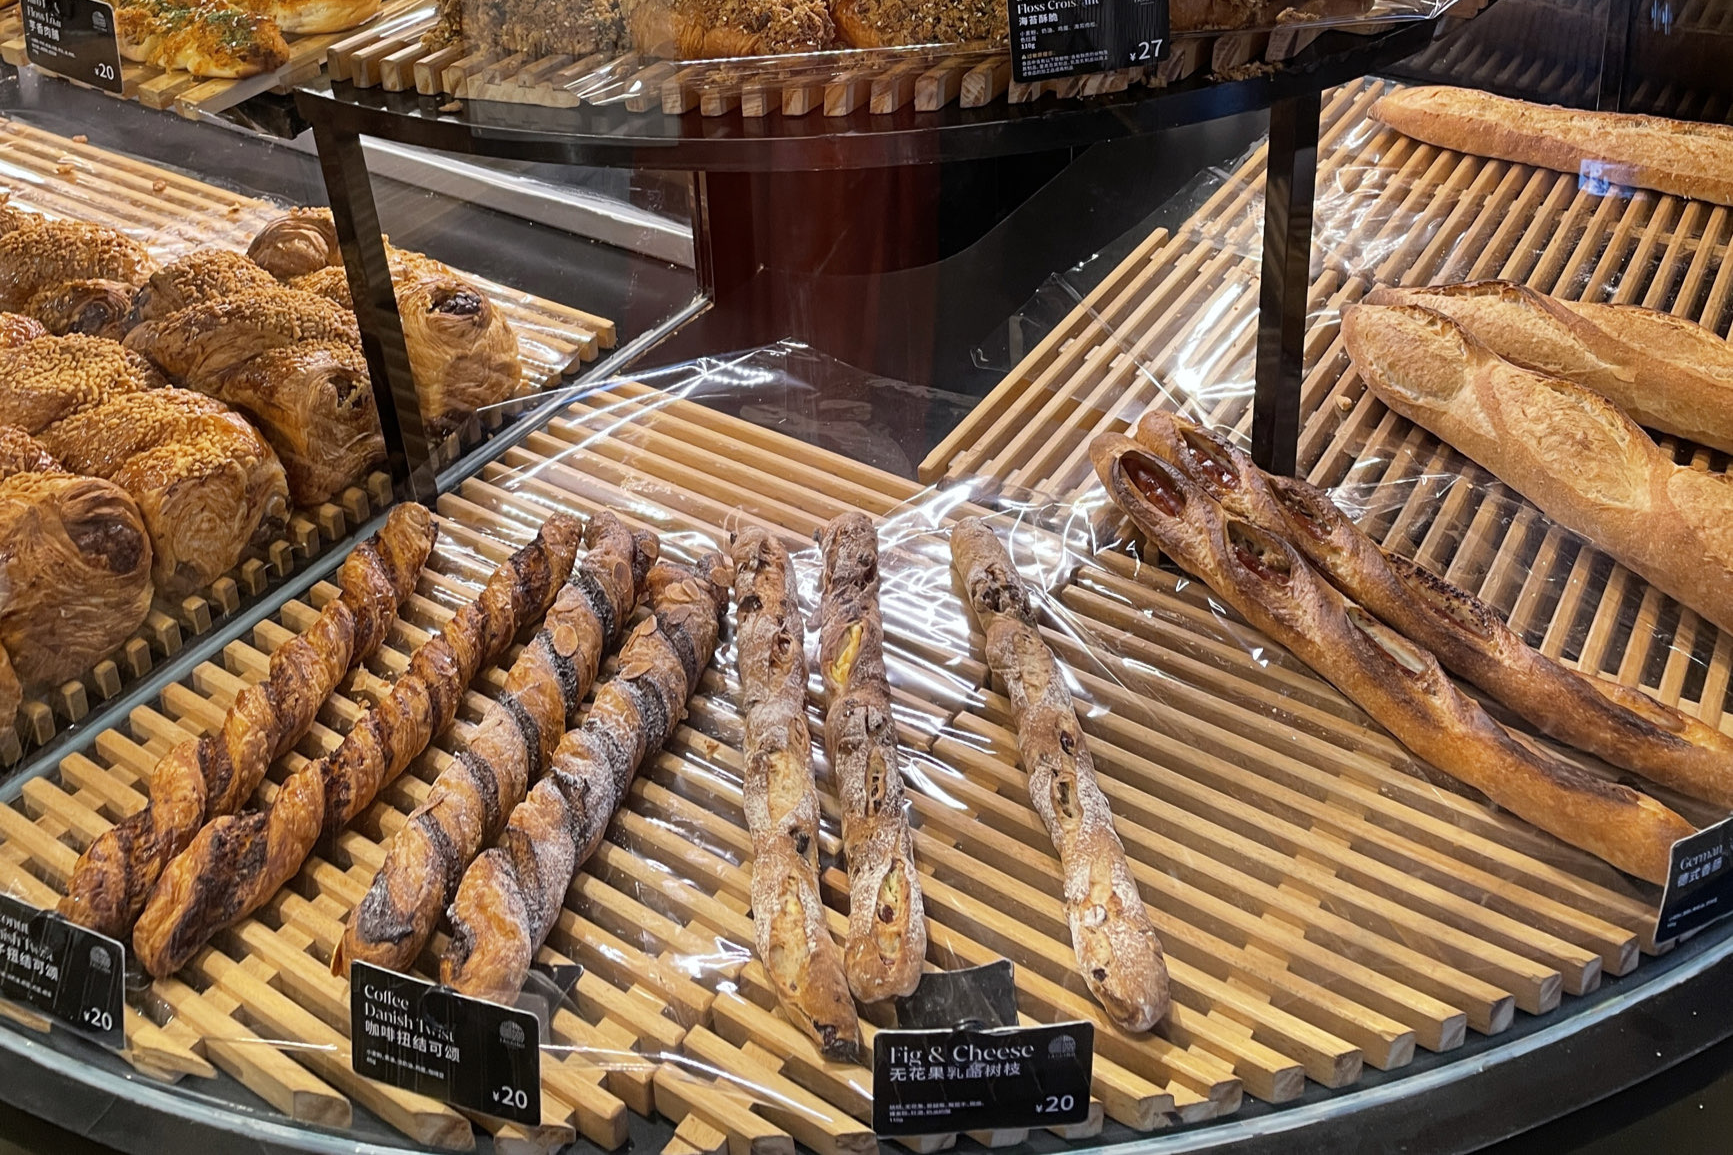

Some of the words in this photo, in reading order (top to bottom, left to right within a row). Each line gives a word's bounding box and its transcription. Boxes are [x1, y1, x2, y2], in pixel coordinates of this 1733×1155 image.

[1017, 1, 1045, 15] Floss
[1130, 39, 1163, 62] ¥27
[95, 63, 114, 81] ¥20
[364, 984, 410, 1011] Coffee
[84, 1007, 113, 1031] ¥20
[364, 1002, 413, 1031] Danish
[365, 1020, 460, 1063] 咖啡扭结可颂
[889, 1046, 923, 1066] Fig
[928, 1047, 946, 1063] &
[952, 1044, 1035, 1063] Cheese
[889, 1062, 1021, 1082] 无花果乳酪树枝
[492, 1085, 528, 1110] ¥20
[1036, 1095, 1075, 1114] ¥20
